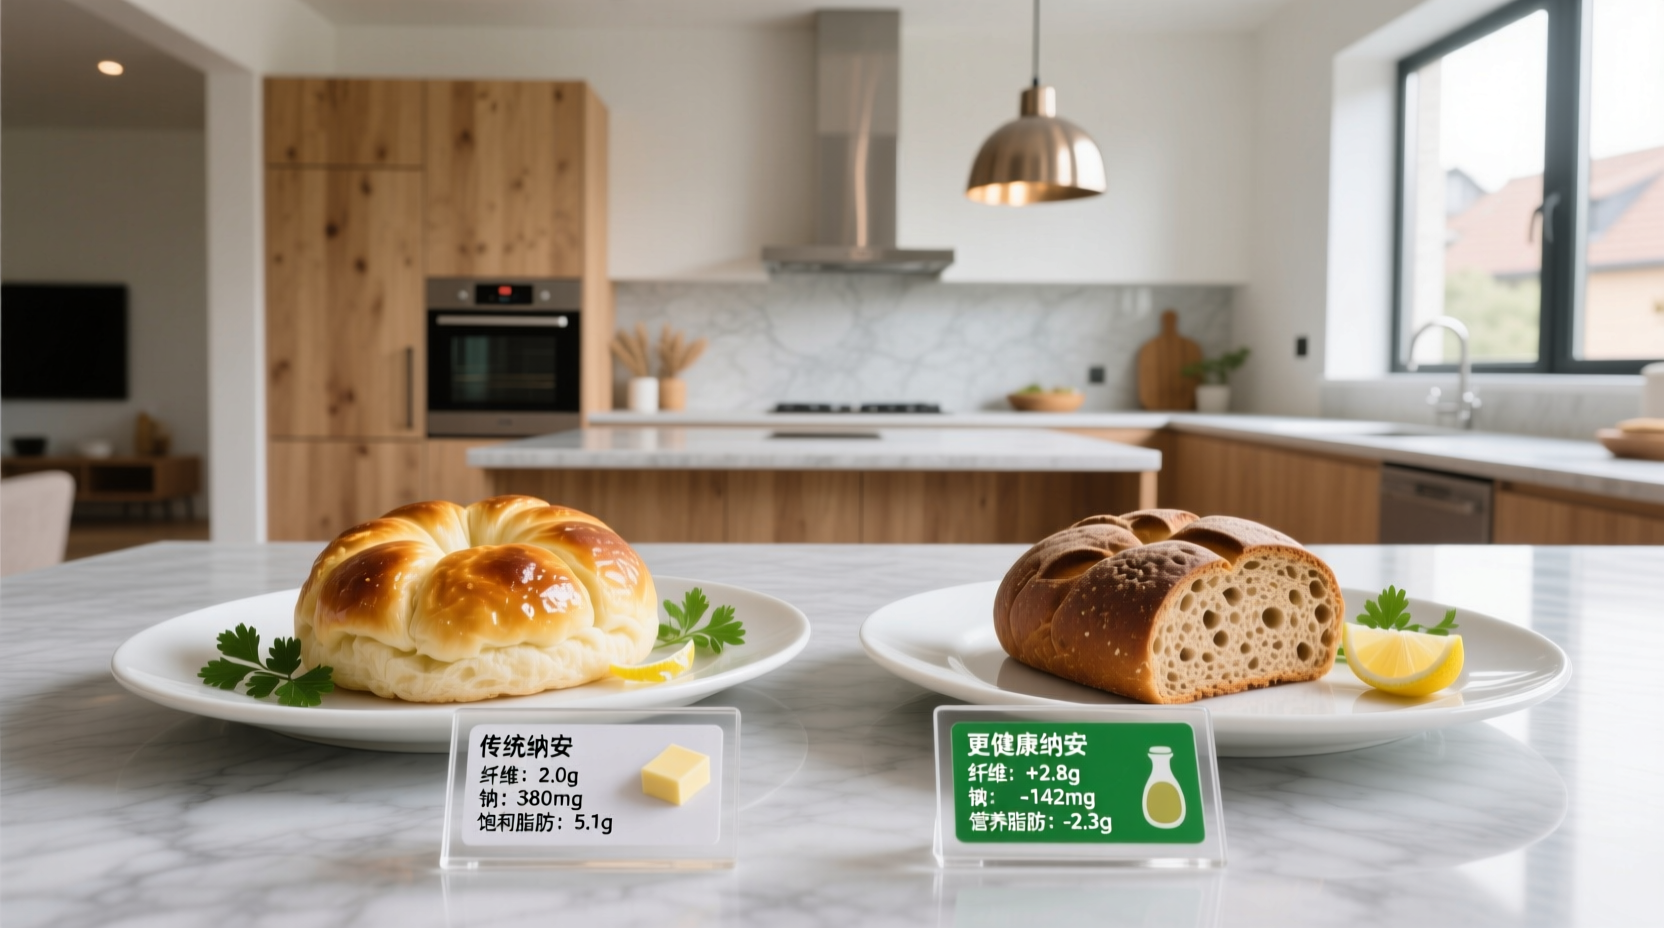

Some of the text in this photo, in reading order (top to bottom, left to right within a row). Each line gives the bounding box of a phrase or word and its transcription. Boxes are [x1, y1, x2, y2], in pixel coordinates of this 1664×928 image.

[479, 734, 573, 759] 传统纳安
[967, 731, 1088, 757] 更健康纳安
[538, 766, 579, 787] 2.0g
[1025, 764, 1081, 786] +2.8g
[516, 789, 583, 811] 380mg
[1020, 788, 1096, 810] -142mg
[574, 813, 613, 835] 5.1g
[1063, 812, 1113, 835] -2.3g
